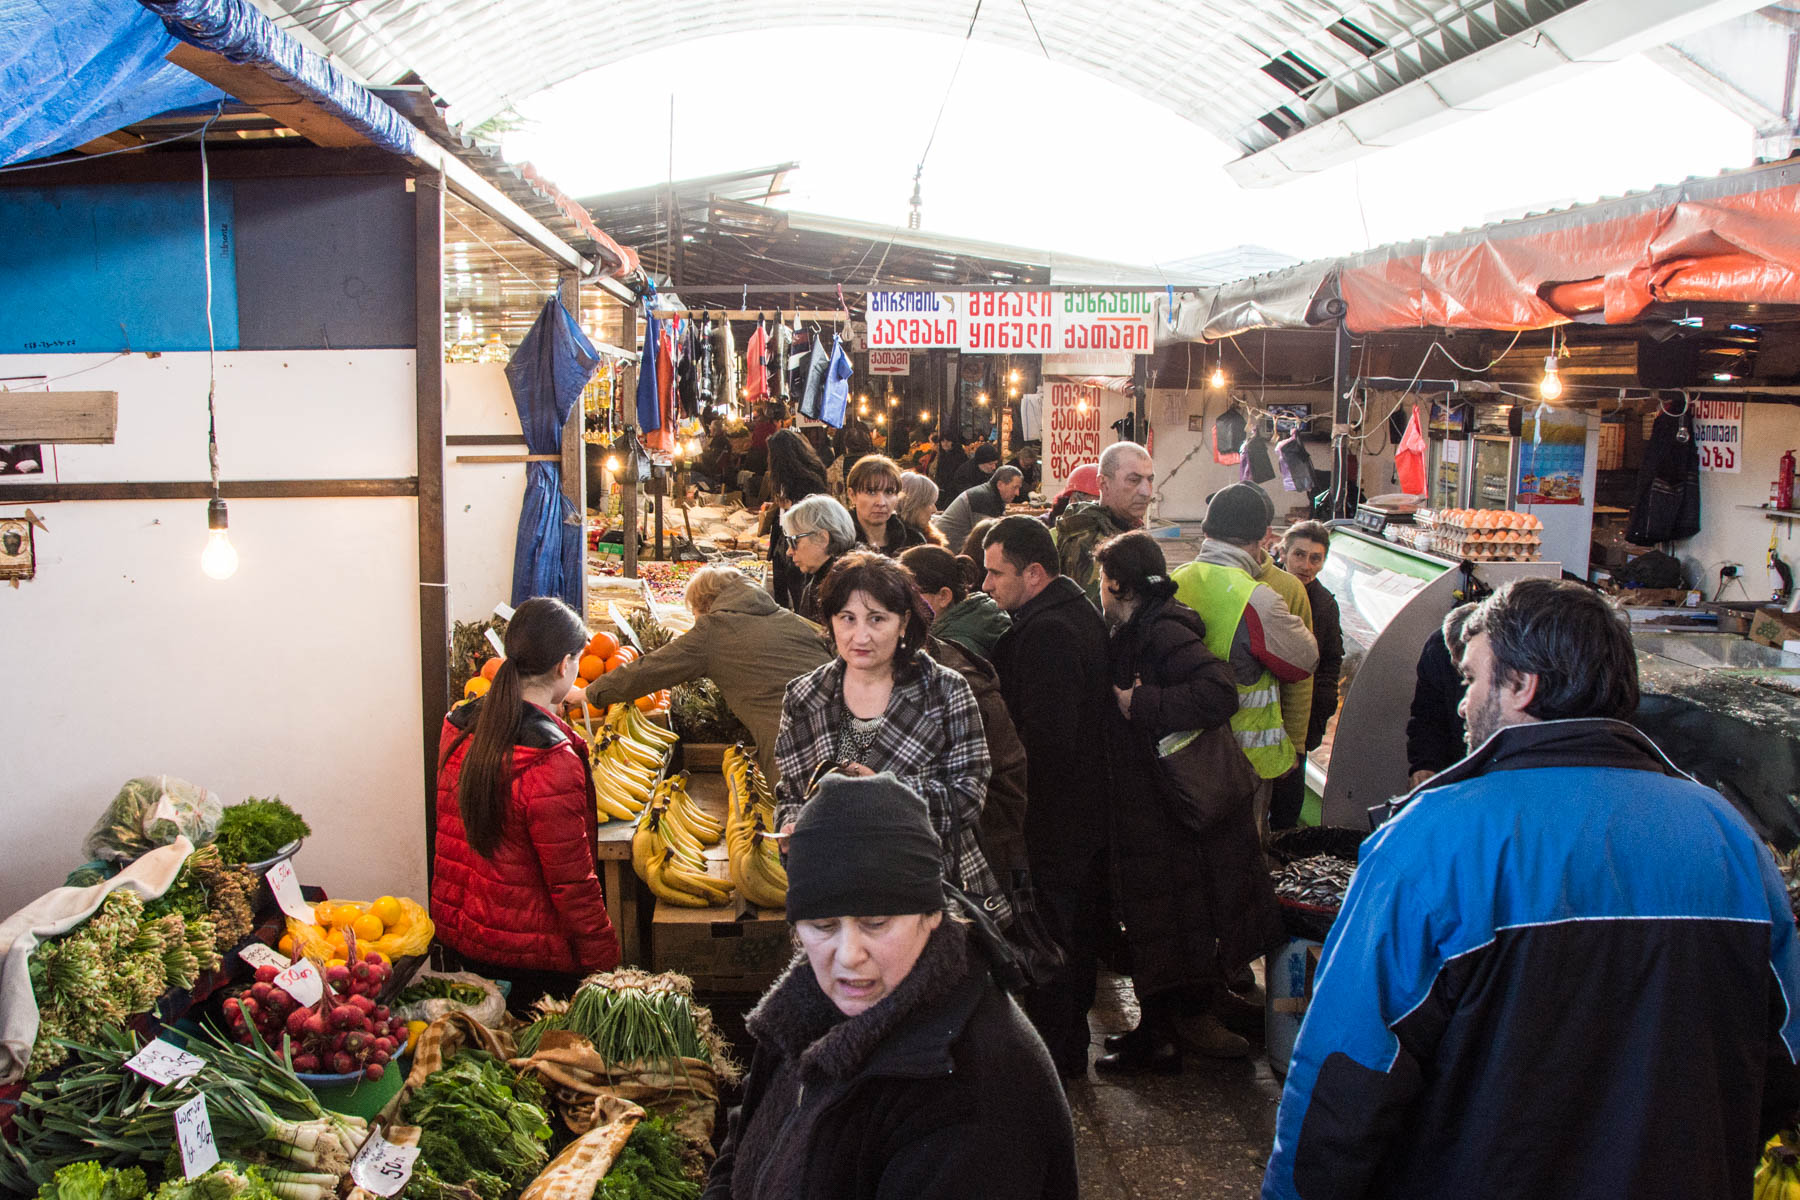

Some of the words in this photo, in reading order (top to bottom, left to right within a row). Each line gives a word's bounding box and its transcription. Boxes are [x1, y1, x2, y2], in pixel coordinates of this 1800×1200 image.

[871, 291, 940, 312] ბორჯომის
[969, 291, 1051, 317] მშრალი
[1064, 291, 1151, 314] მუხრანის
[872, 319, 958, 345] კალმახი
[969, 322, 1051, 349] ყინული
[1064, 324, 1149, 350] ქათამი
[871, 352, 909, 365] ქათამი
[1691, 400, 1741, 419] აყინის
[1051, 432, 1100, 456] ბარკალი
[1695, 425, 1737, 442] აბითუმო
[1699, 446, 1735, 468] აზა
